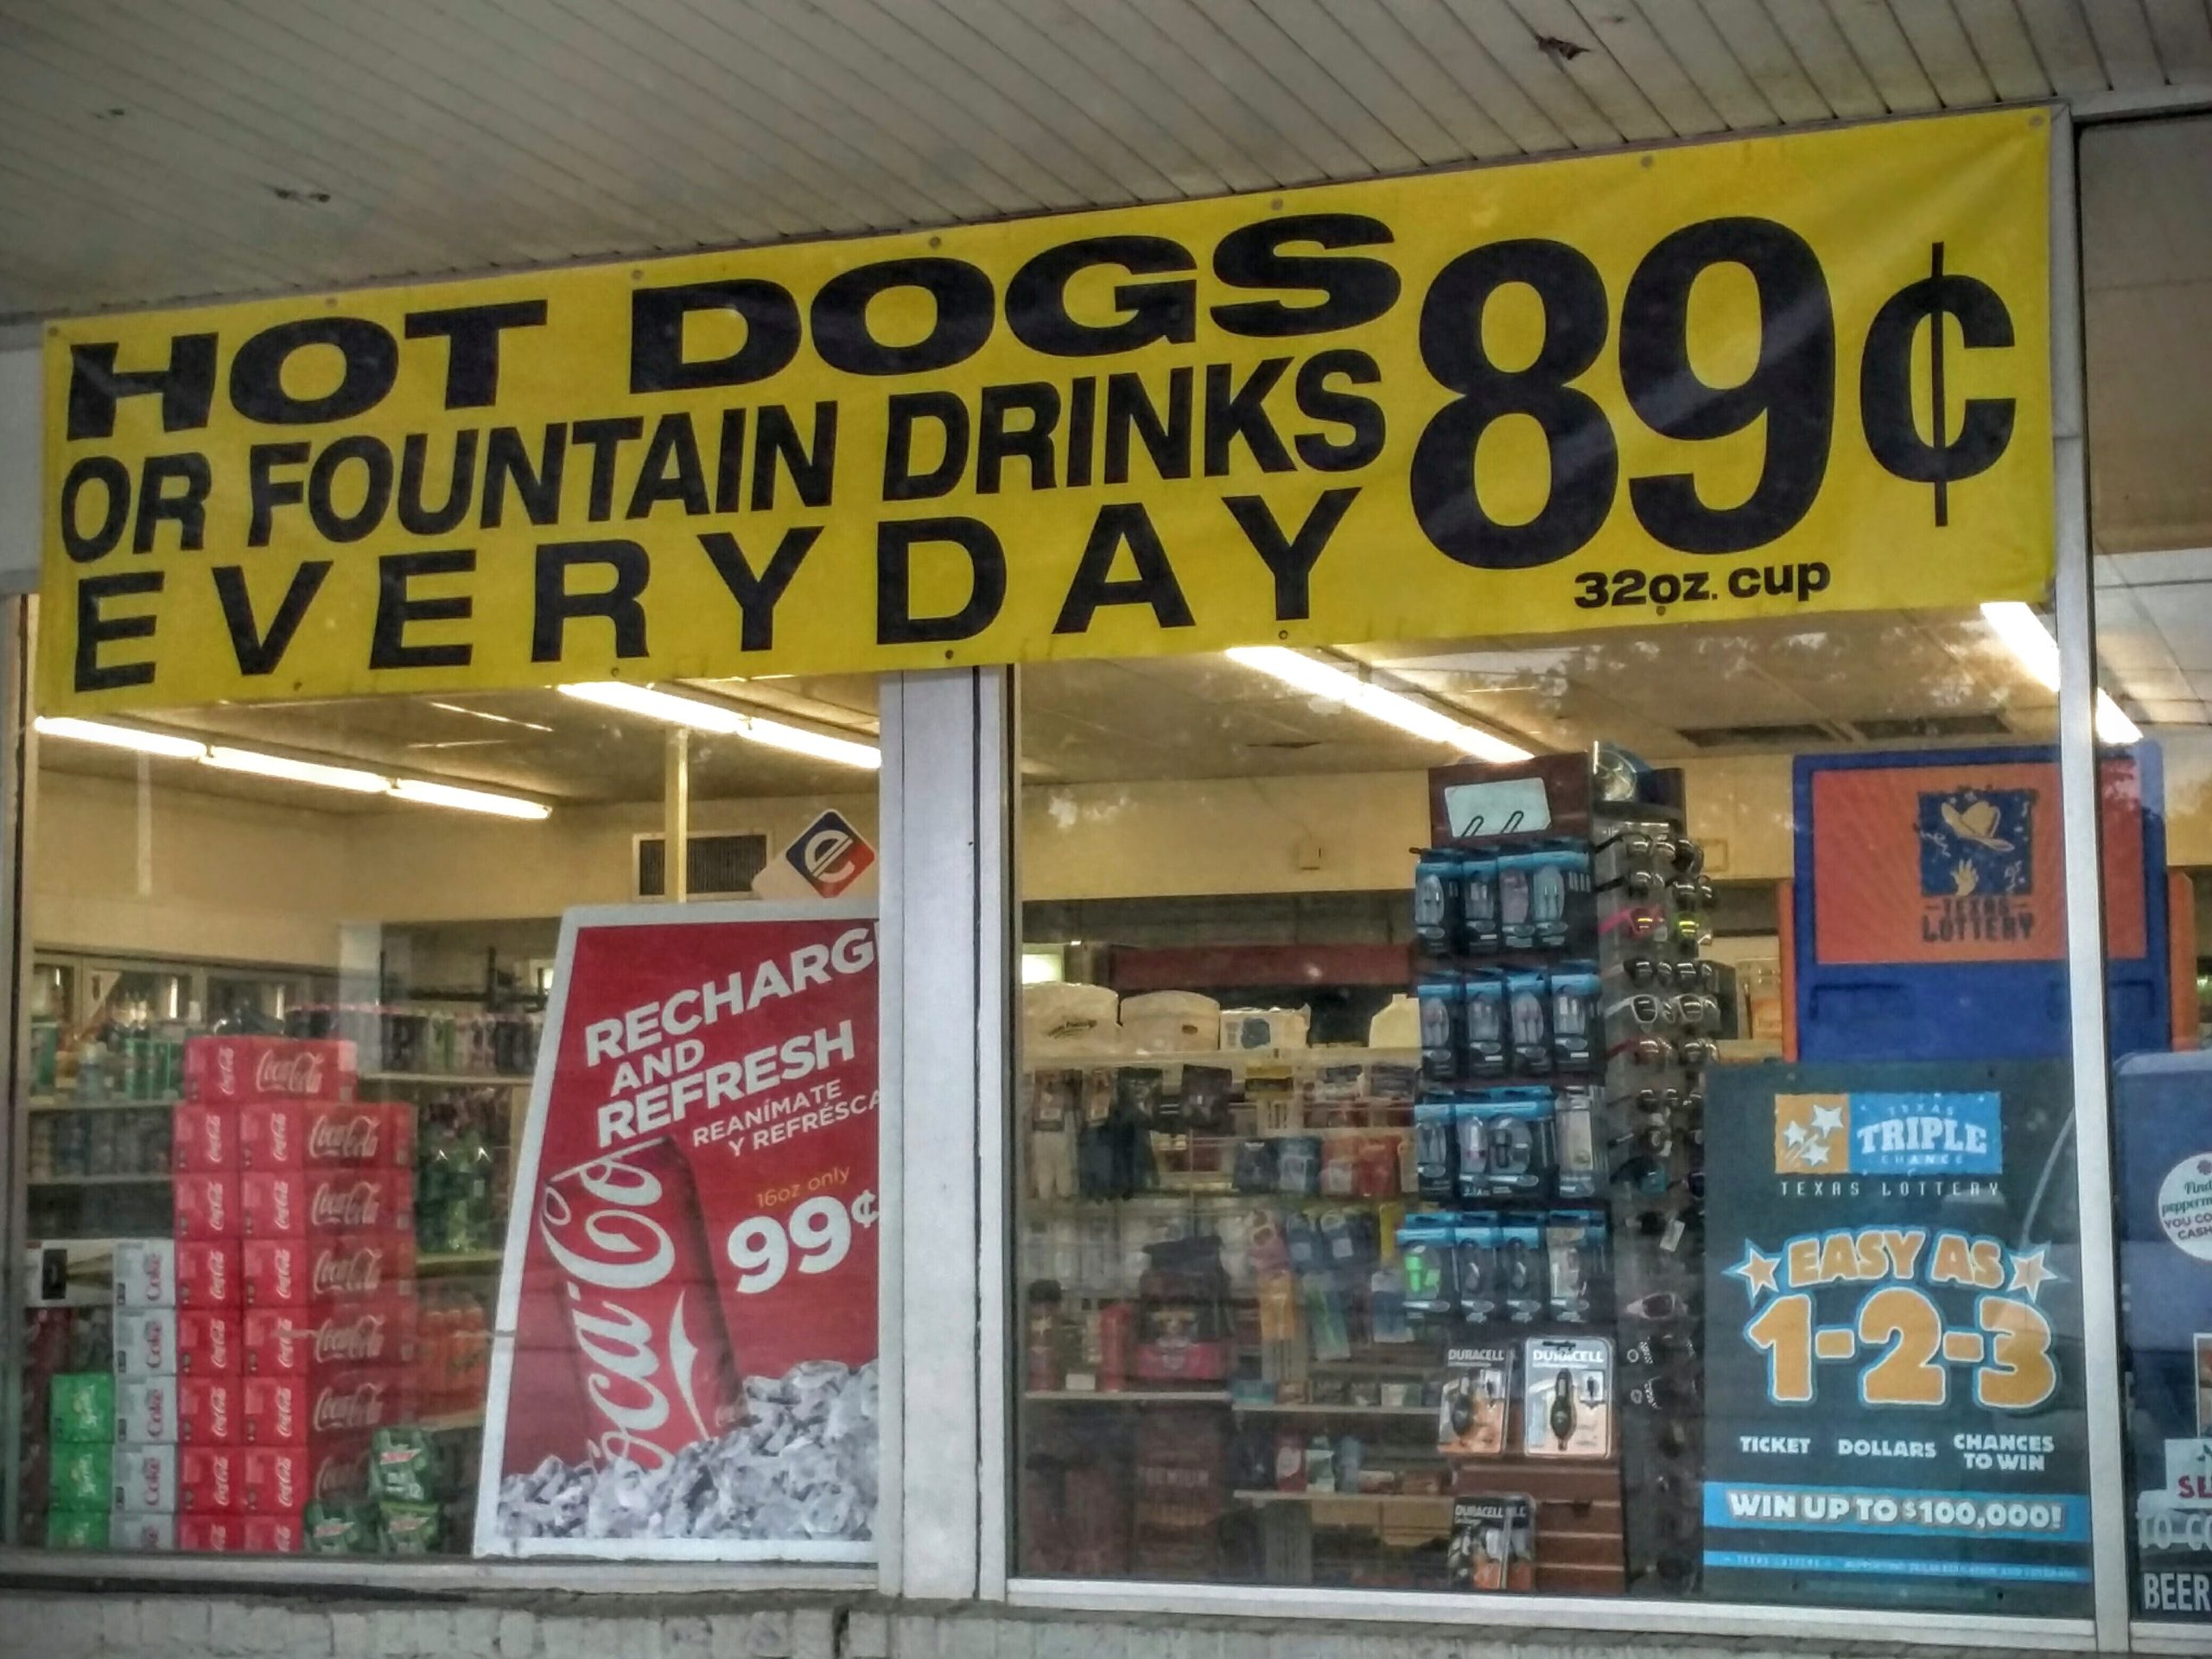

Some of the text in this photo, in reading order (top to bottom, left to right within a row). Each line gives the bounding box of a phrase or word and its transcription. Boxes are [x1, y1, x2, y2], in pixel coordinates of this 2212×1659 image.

[67, 213, 1402, 441] HOT DOGS
[61, 349, 1386, 563] OR FOUNTAIN DRINKS
[1574, 562, 1830, 609] 32oz. cup
[1923, 914, 2034, 942] LOTTERY
[585, 925, 879, 1067] RECHARG
[596, 1020, 855, 1147] REFRESH
[610, 1039, 705, 1096] AND
[693, 1079, 842, 1147] REANÍMATE
[728, 1138, 743, 1157] Y
[1858, 1117, 1987, 1154] TRIPLE
[756, 1166, 851, 1209] 16oz only
[1781, 1181, 1999, 1198] TEXAS LOTTERY
[2164, 1216, 2192, 1229] YOU
[1788, 1230, 2004, 1288] EASY AS
[1448, 1349, 1504, 1361] DURACELL
[1533, 1350, 1605, 1363] DURACELL
[1746, 1287, 2056, 1408] 1-2-3
[1740, 1435, 1936, 1459] TICKET DOLLARS
[1954, 1433, 2054, 1453] CHANCES
[1963, 1453, 2045, 1471] TO WIN
[1455, 1504, 1503, 1518] DURACELL
[1729, 1493, 2063, 1529] WIN UP TO $100,000!
[2143, 1573, 2211, 1611] BEER
